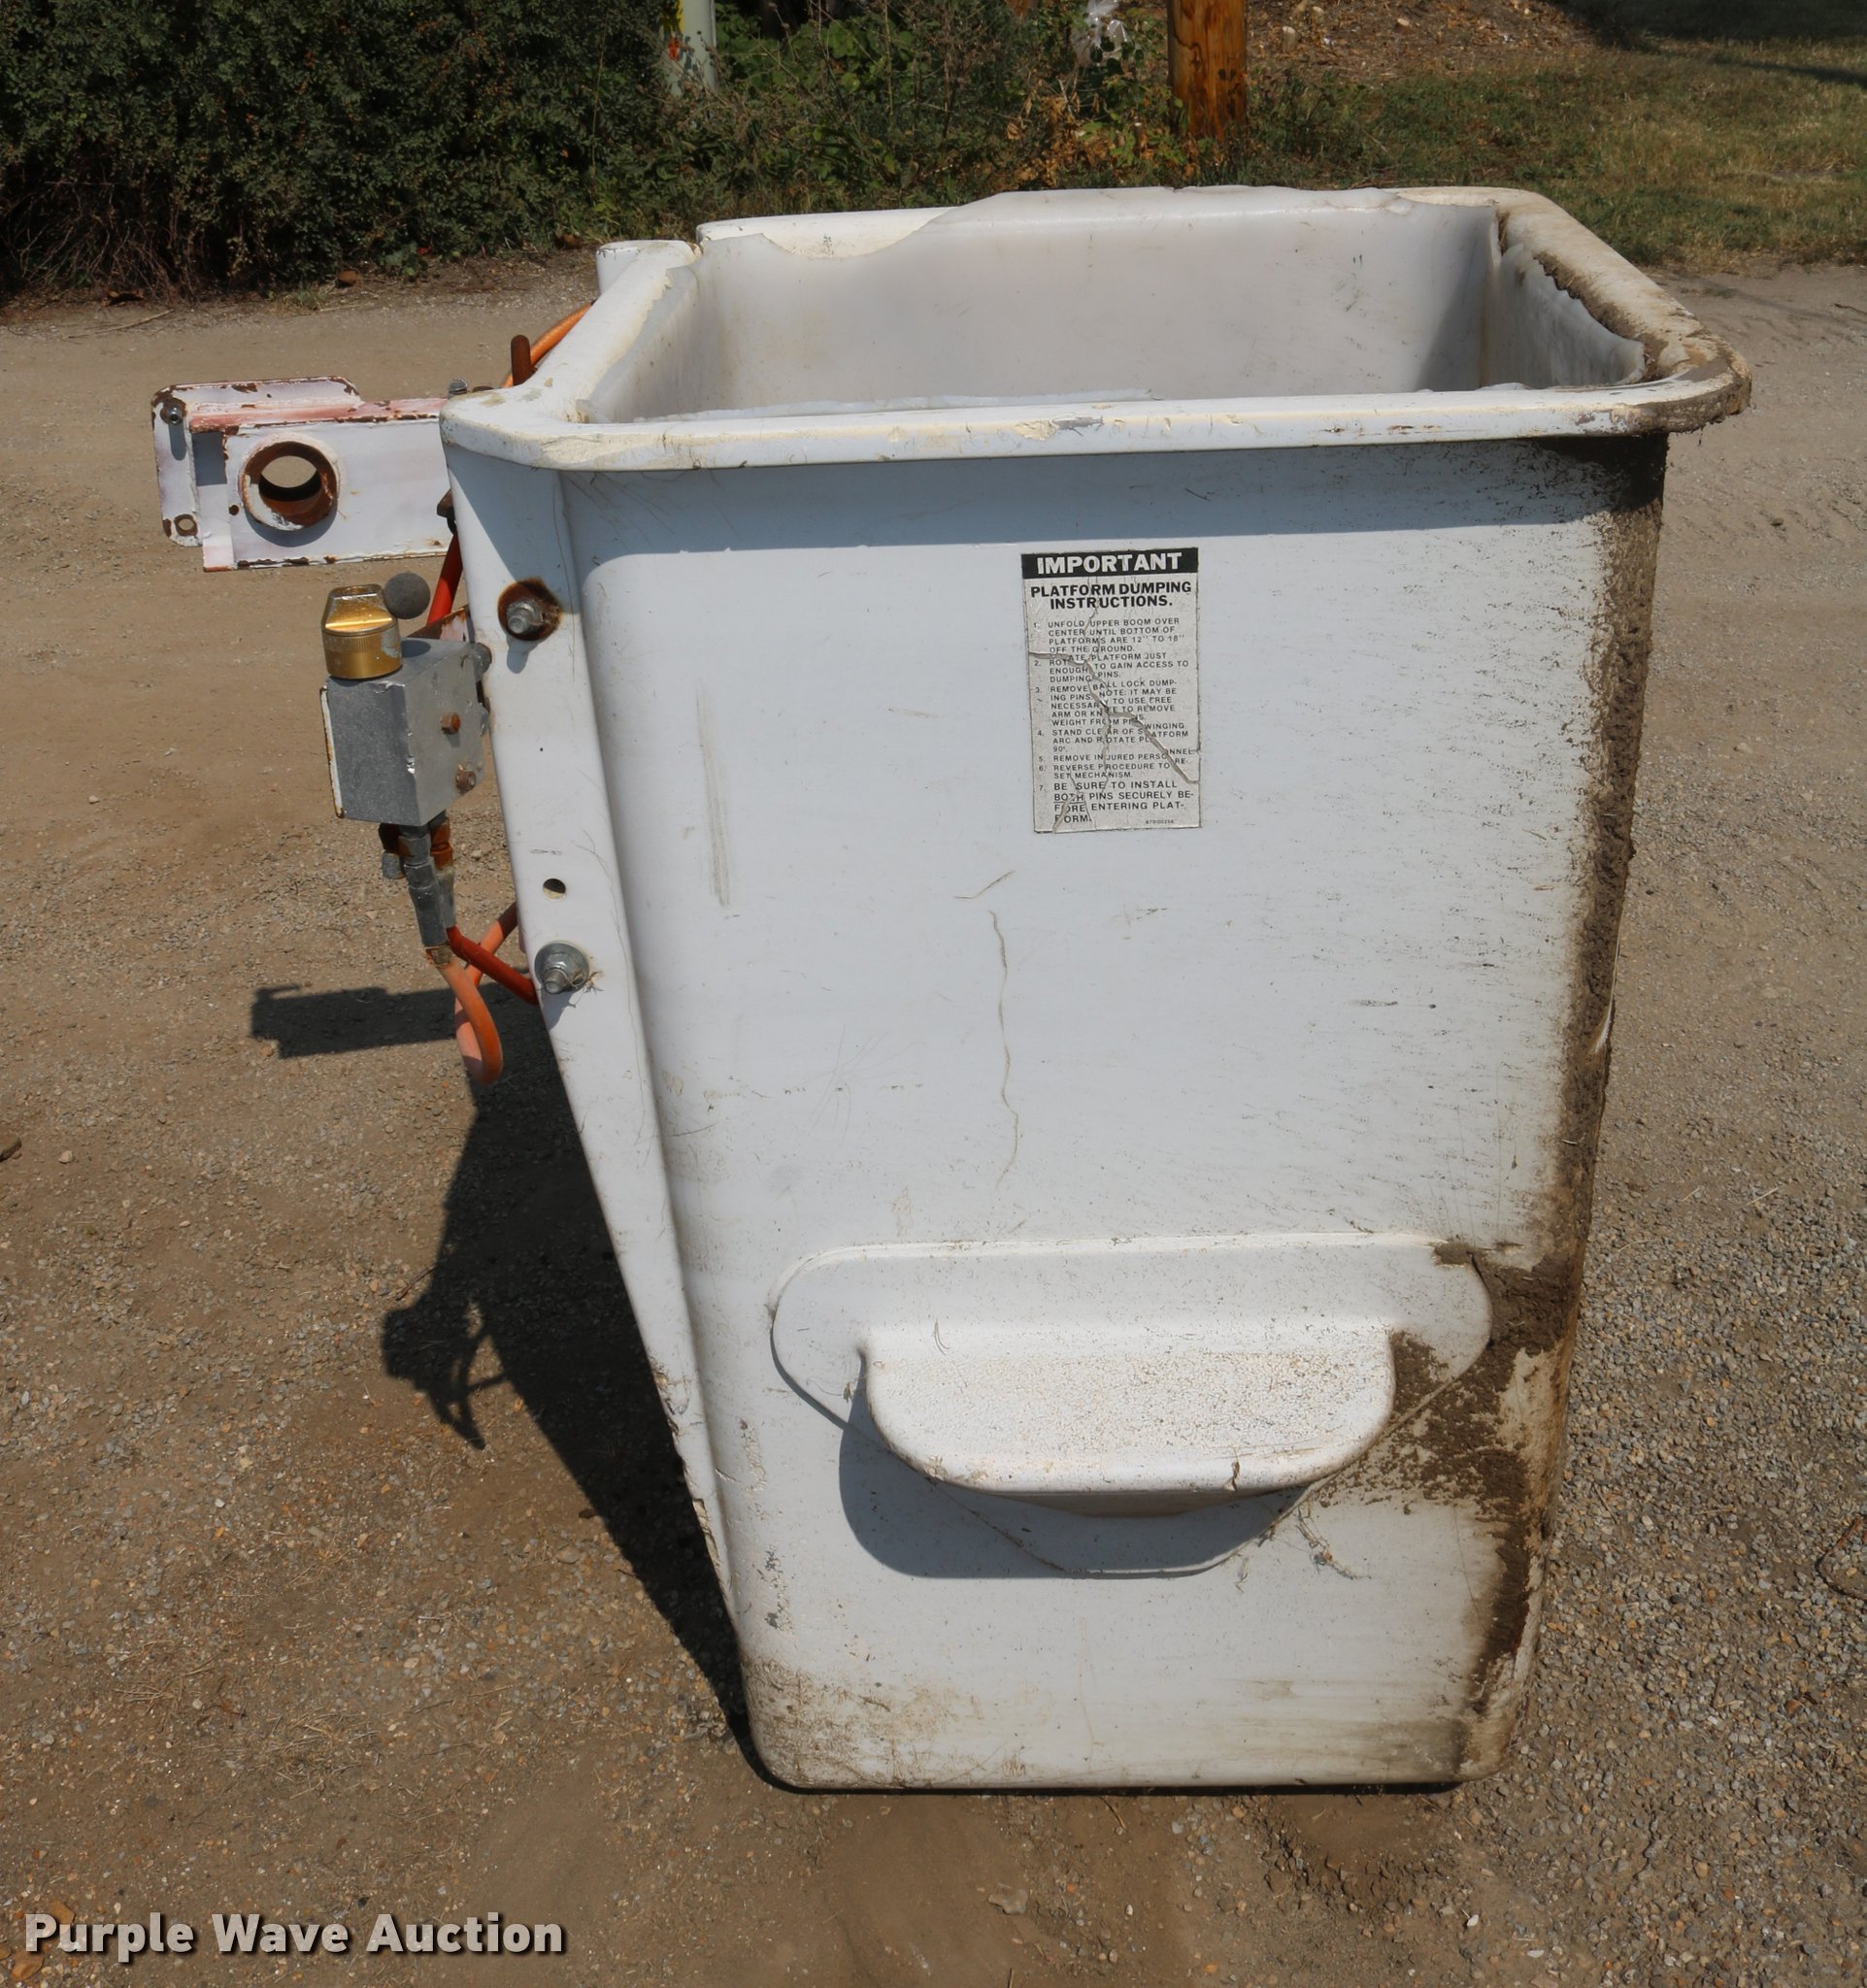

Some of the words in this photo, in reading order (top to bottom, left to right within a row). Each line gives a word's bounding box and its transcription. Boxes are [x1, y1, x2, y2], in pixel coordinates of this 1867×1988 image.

[1037, 552, 1183, 575] IMPORTANT
[1030, 583, 1116, 598] PLATFORM
[1118, 581, 1192, 595] DUMPING
[1050, 595, 1173, 610] INSTRUCTIONS.
[1120, 626, 1159, 635] BOTTOM
[1049, 637, 1107, 646] PLATFORMS
[1092, 645, 1135, 653] GROUND.
[1050, 654, 1086, 666] ROTATE
[1091, 652, 1141, 661] PLATFORM
[1145, 651, 1166, 660] JUST
[1136, 660, 1174, 669] ACCESS
[1050, 675, 1092, 683] DUMPING
[1097, 670, 1121, 679] PINS.
[1050, 684, 1088, 693] REMOVE
[1093, 681, 1117, 690] BALL
[1099, 689, 1127, 698] NOTE:
[1096, 736, 1136, 745] ROTATE
[1098, 762, 1154, 771] PROCEDURE
[1053, 782, 1068, 791] BE
[1076, 781, 1106, 790] SURE
[1112, 781, 1126, 790] TO
[1130, 780, 1178, 789] INSTALL
[1053, 793, 1084, 803] BOTH
[1089, 792, 1114, 801] PINS
[1117, 790, 1173, 801] SECURELY
[1178, 790, 1194, 799] BE-
[1091, 802, 1148, 812] ENTERING
[1152, 801, 1184, 810] PLAT-
